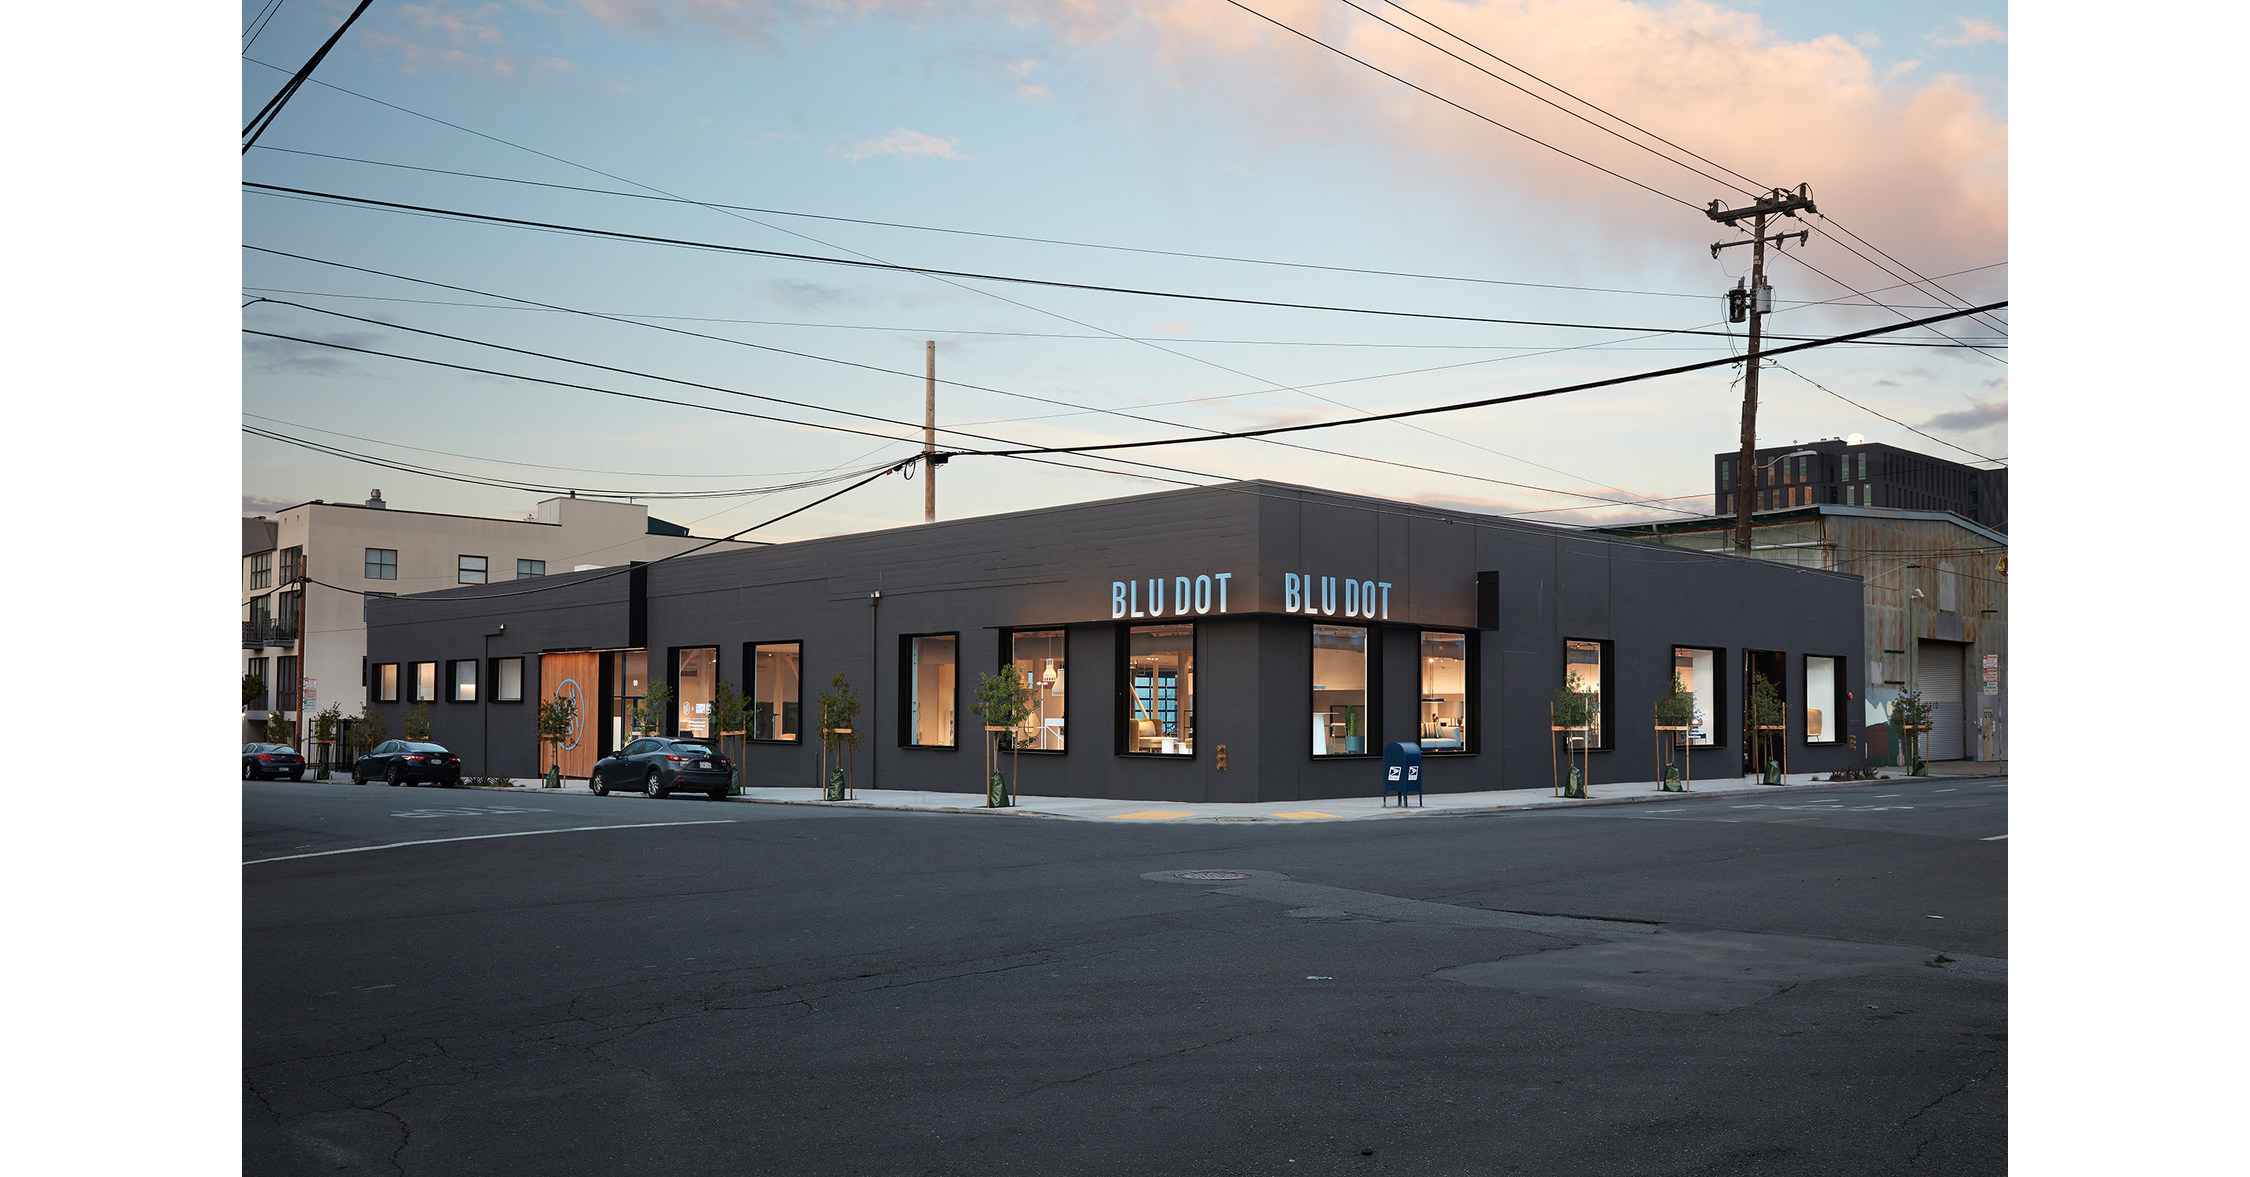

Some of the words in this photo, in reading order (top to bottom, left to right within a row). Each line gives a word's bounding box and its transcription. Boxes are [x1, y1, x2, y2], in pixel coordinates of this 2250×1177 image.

[1112, 578, 1164, 619] BLU
[1175, 572, 1232, 616] DOT
[1285, 572, 1336, 616] BLU
[1345, 578, 1392, 620] DOT
